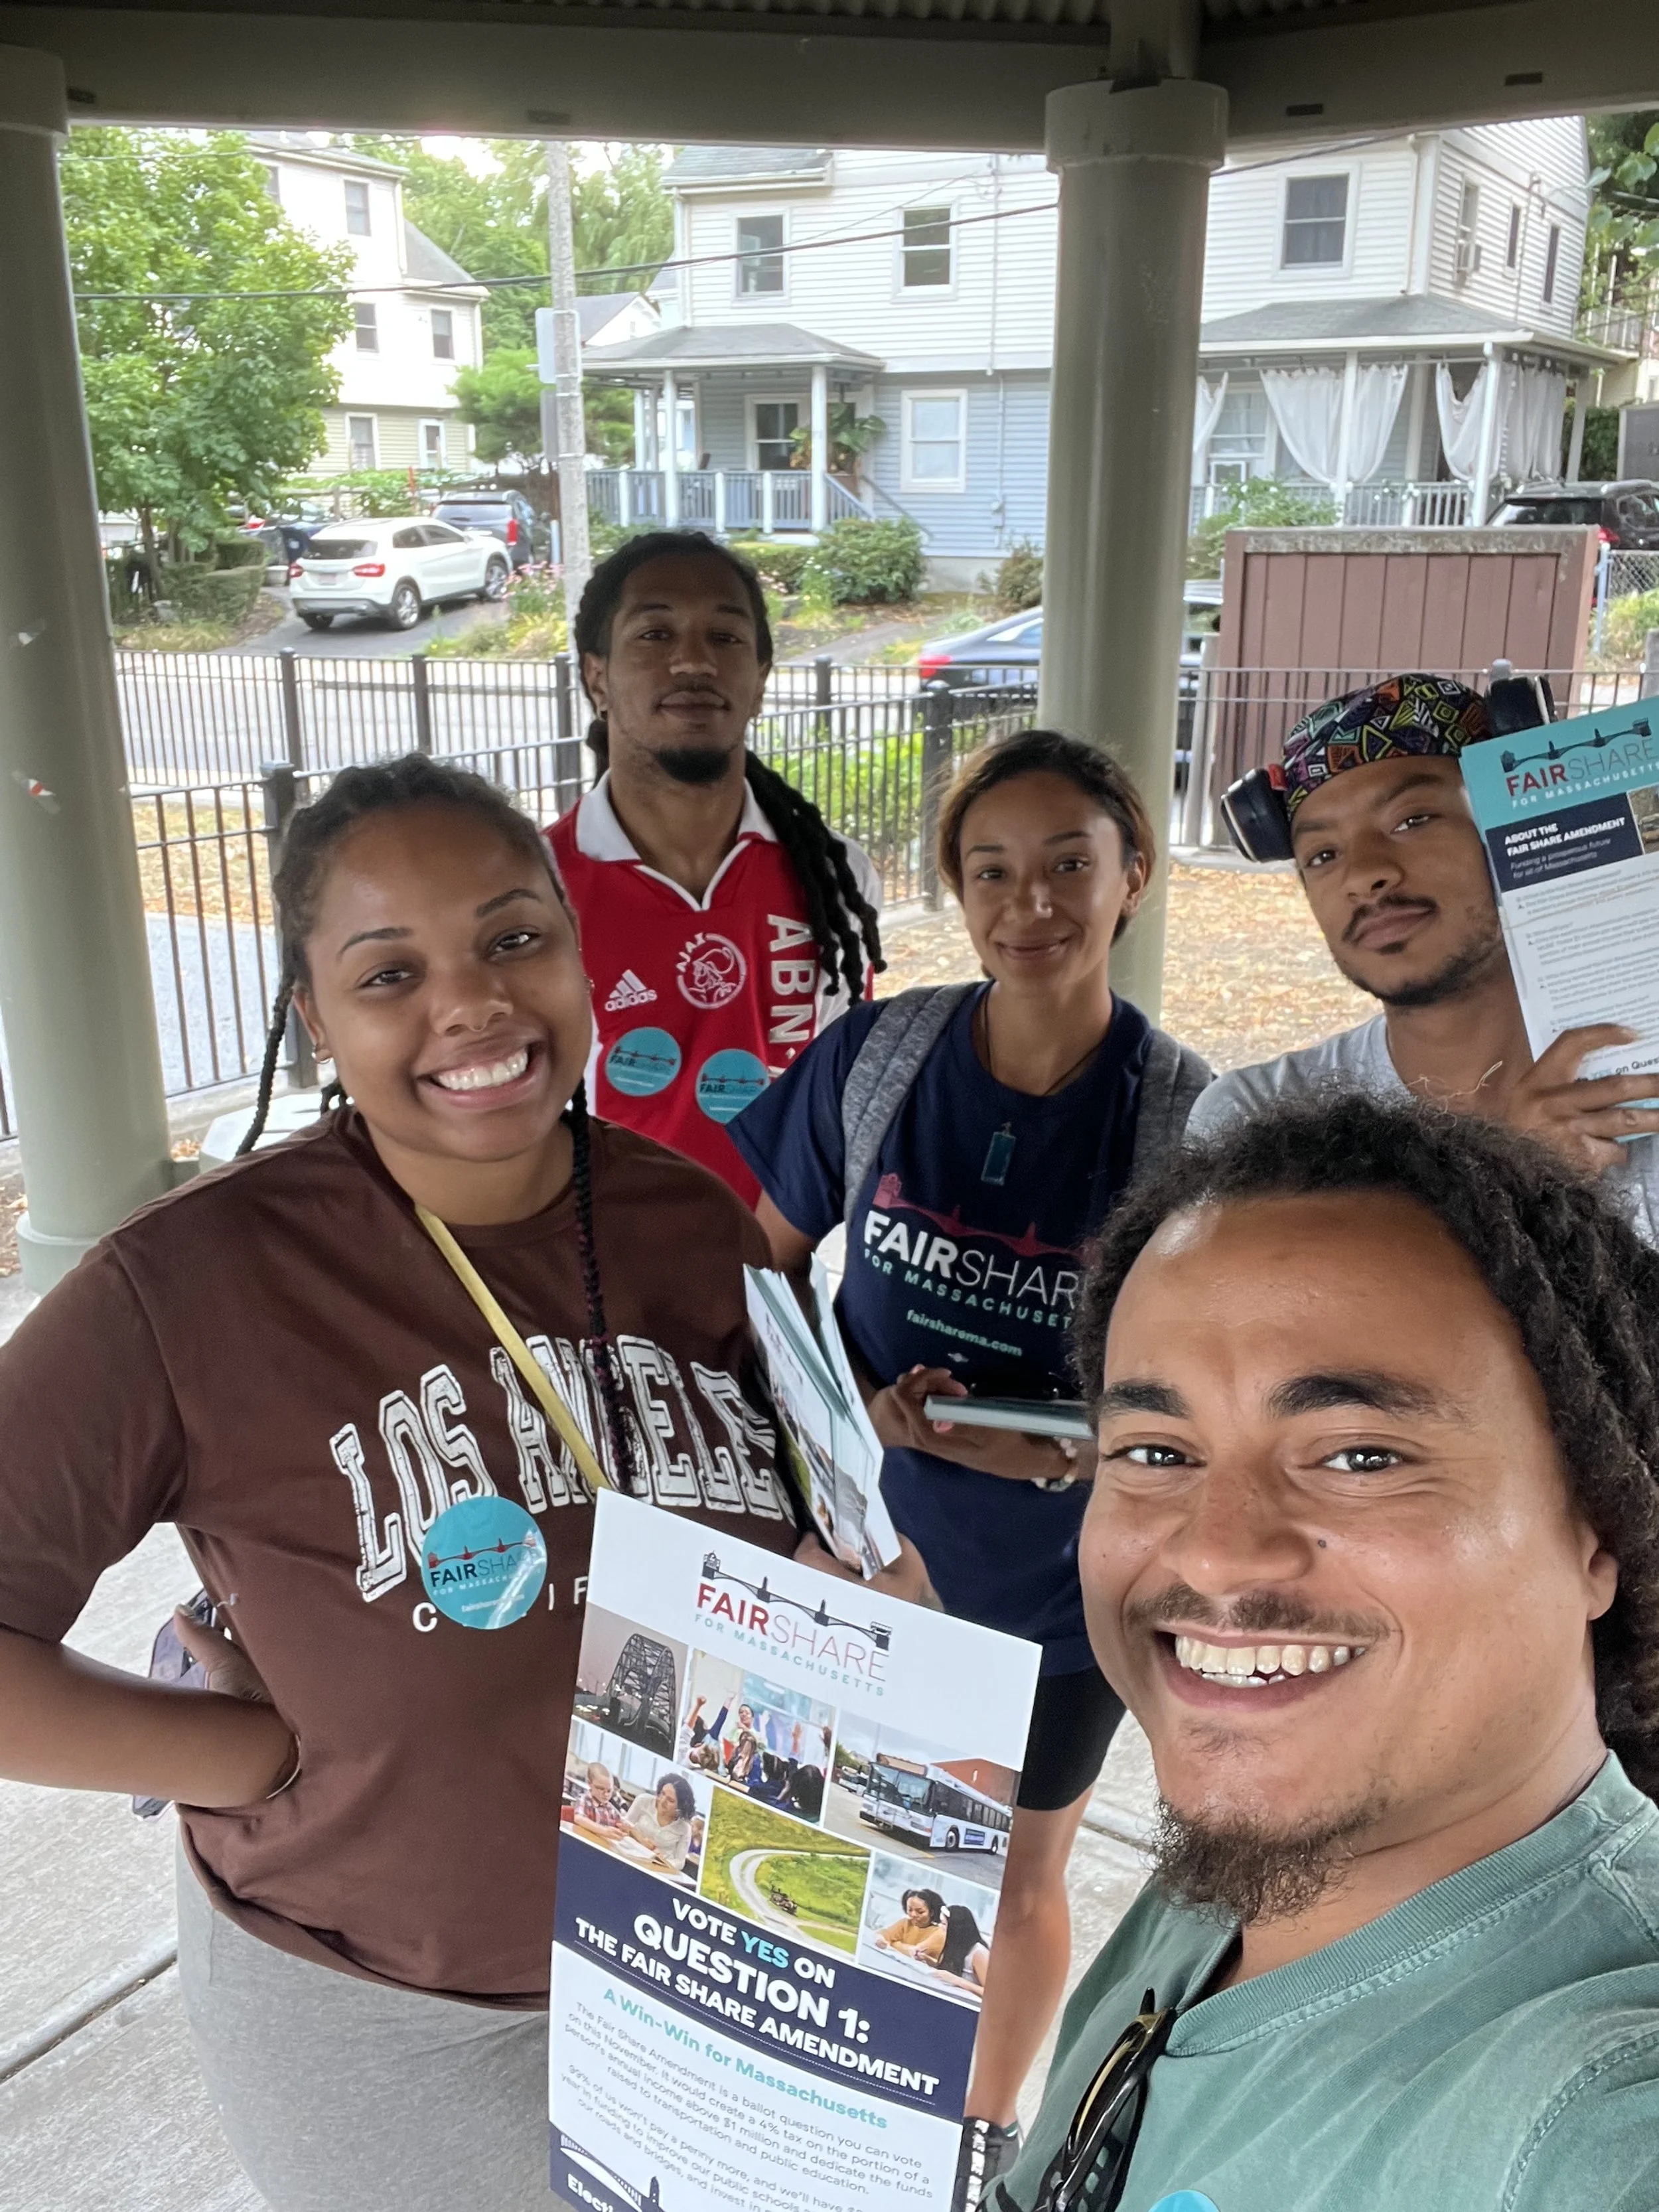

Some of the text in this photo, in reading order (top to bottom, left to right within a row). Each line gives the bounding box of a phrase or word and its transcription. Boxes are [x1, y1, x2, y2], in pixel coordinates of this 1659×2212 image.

[1506, 737, 1658, 796] FAIRSHARE
[1512, 796, 1537, 808] FOR
[1504, 823, 1558, 845] ABOUT THE
[1507, 817, 1625, 856] FAIR SHARE AMENDMENT
[604, 989, 658, 1012] adidas
[676, 931, 707, 973] AJAX
[864, 1210, 1082, 1310] FAIRSHAR
[864, 1248, 1073, 1329] FOR MASSACHUSET
[906, 1309, 1023, 1357] fairsharema.com
[329, 1334, 796, 1603] LOS ANGELE
[694, 1613, 885, 1697] FOR MASSACHUSETTS
[697, 1582, 889, 1682] FAIRSHARE
[633, 1914, 871, 2044] QUESTION 1:
[672, 1897, 835, 1988] VOTE YES ON
[574, 1917, 940, 2095] THE FAIR SHARE AMENDMENT
[568, 2013, 581, 2026] on
[584, 2020, 602, 2039] this
[672, 2077, 705, 2101] would
[709, 2097, 745, 2119] create
[749, 2115, 756, 2124] a
[759, 2119, 780, 2135] 4%
[783, 2129, 802, 2144] tax
[806, 2139, 823, 2152] on
[827, 2145, 847, 2160] the
[851, 2156, 900, 2176] portion
[904, 2169, 918, 2181] of
[922, 2175, 930, 2185] a
[576, 2002, 922, 2169] The Fair Share Amendment is a ballot question you can vote
[603, 1988, 888, 2128] A Win-Win for Massachusetts
[583, 2089, 592, 2101] in
[594, 2094, 631, 2130] funding
[633, 2124, 644, 2136] to
[646, 2134, 688, 2165] improve
[691, 2161, 711, 2175] our
[713, 2174, 749, 2195] public
[753, 2191, 800, 2212] schools
[593, 2083, 603, 2095] of
[605, 2093, 616, 2104] us
[650, 2122, 669, 2139] pay
[670, 2134, 678, 2144] a
[680, 2140, 715, 2165] penny
[717, 2160, 749, 2183] more,
[754, 2176, 777, 2191] and
[812, 2196, 843, 2212] have
[607, 2065, 869, 2195] raised to transportation and public education.
[608, 2050, 640, 2079] annual
[644, 2073, 683, 2103] income
[685, 2098, 720, 2122] above
[723, 2116, 737, 2130] $1
[739, 2126, 780, 2150] million
[783, 2146, 807, 2160] and
[810, 2155, 865, 2179] dedicate
[869, 2173, 891, 2187] the
[896, 2181, 933, 2199] funds
[623, 2132, 642, 2148] and
[644, 2144, 684, 2177] bridges,
[687, 2174, 707, 2189] and
[710, 2186, 745, 2207] invest
[749, 2201, 761, 2212] in
